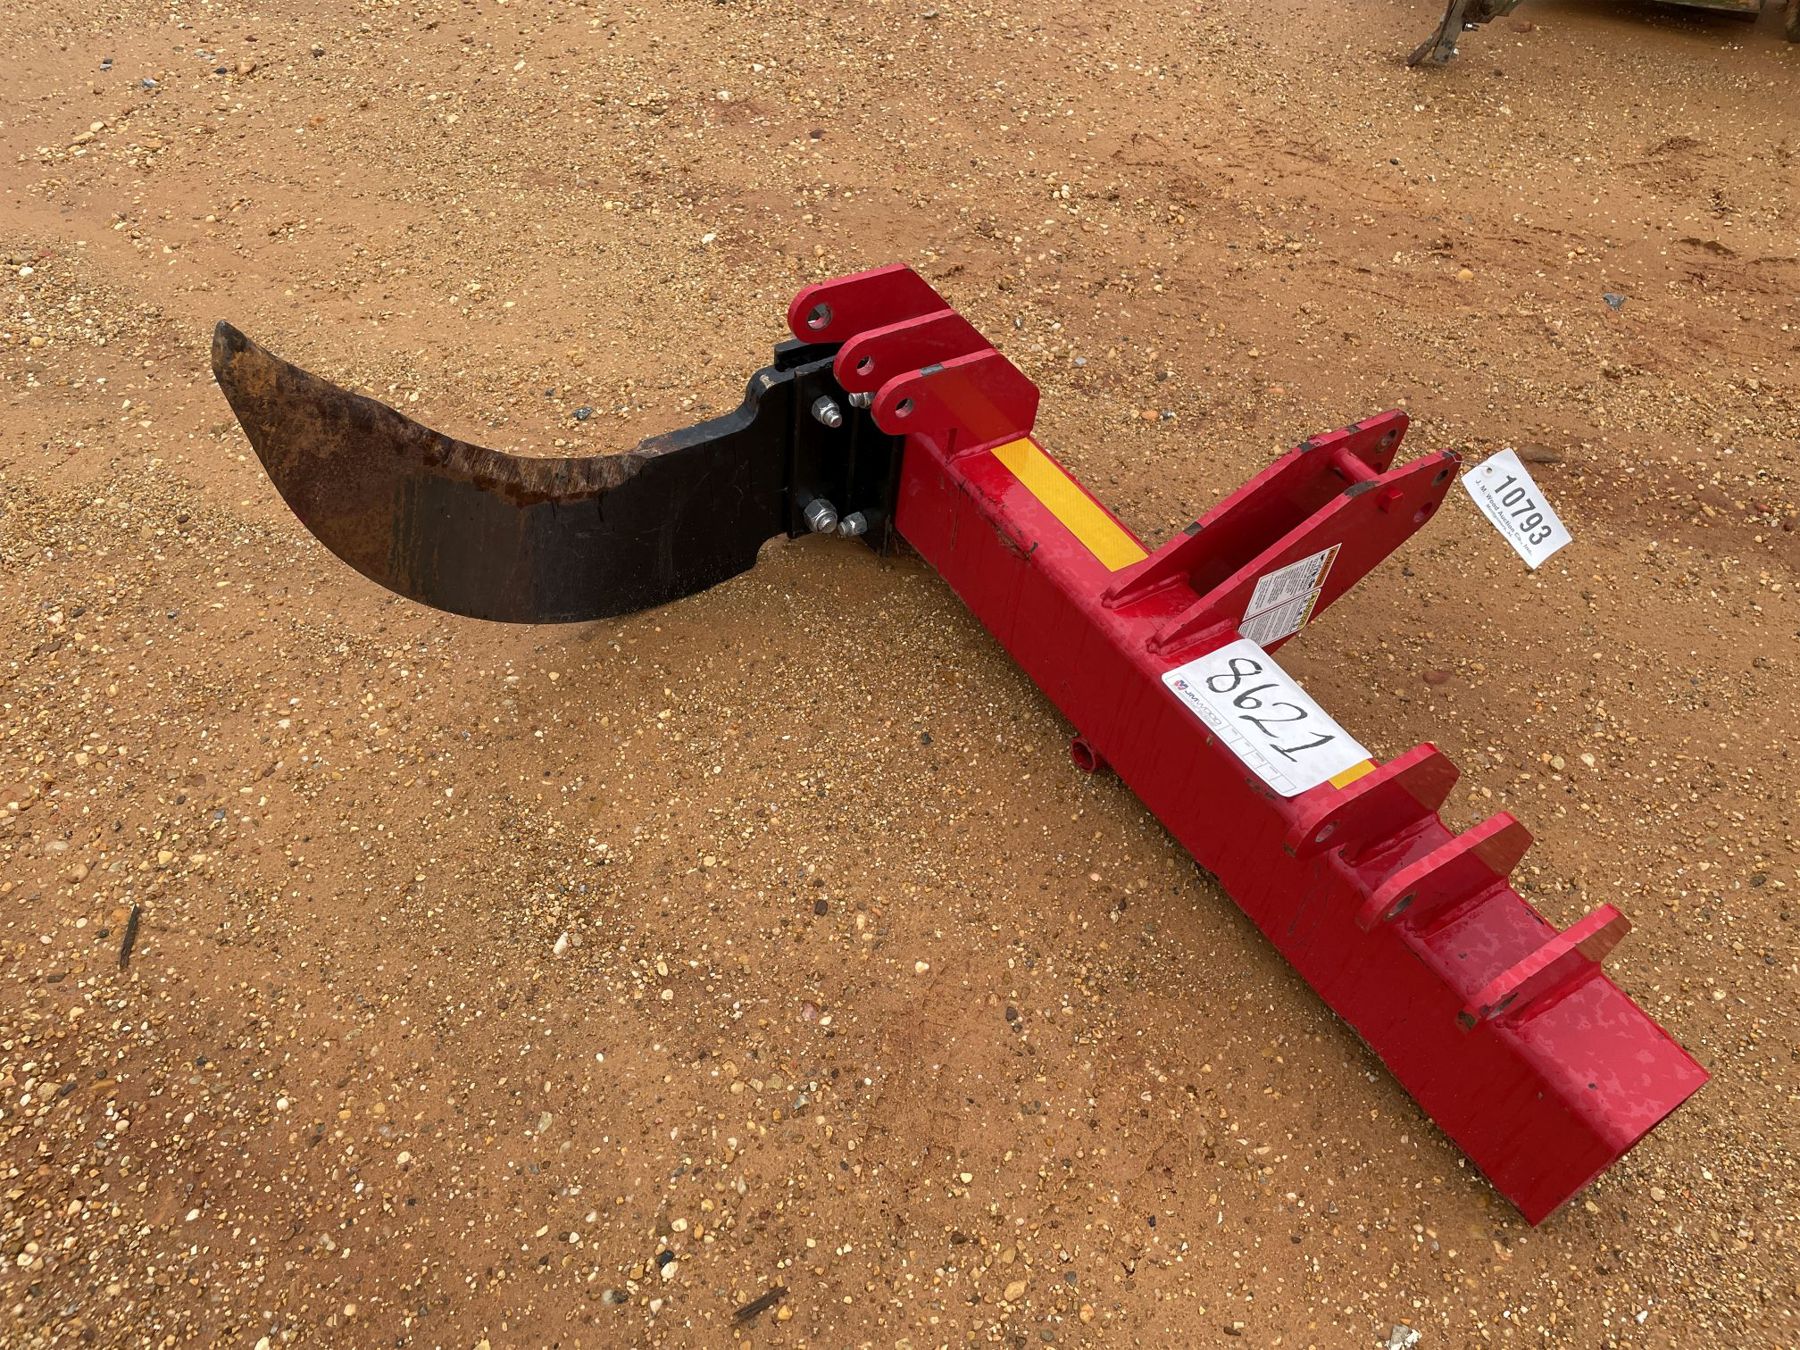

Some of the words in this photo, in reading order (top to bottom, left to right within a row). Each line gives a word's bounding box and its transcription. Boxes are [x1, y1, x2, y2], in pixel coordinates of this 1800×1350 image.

[1486, 494, 1499, 512] Wood
[1498, 511, 1515, 532] Auction
[1495, 475, 1552, 545] 10793
[1205, 658, 1336, 762] 8621
